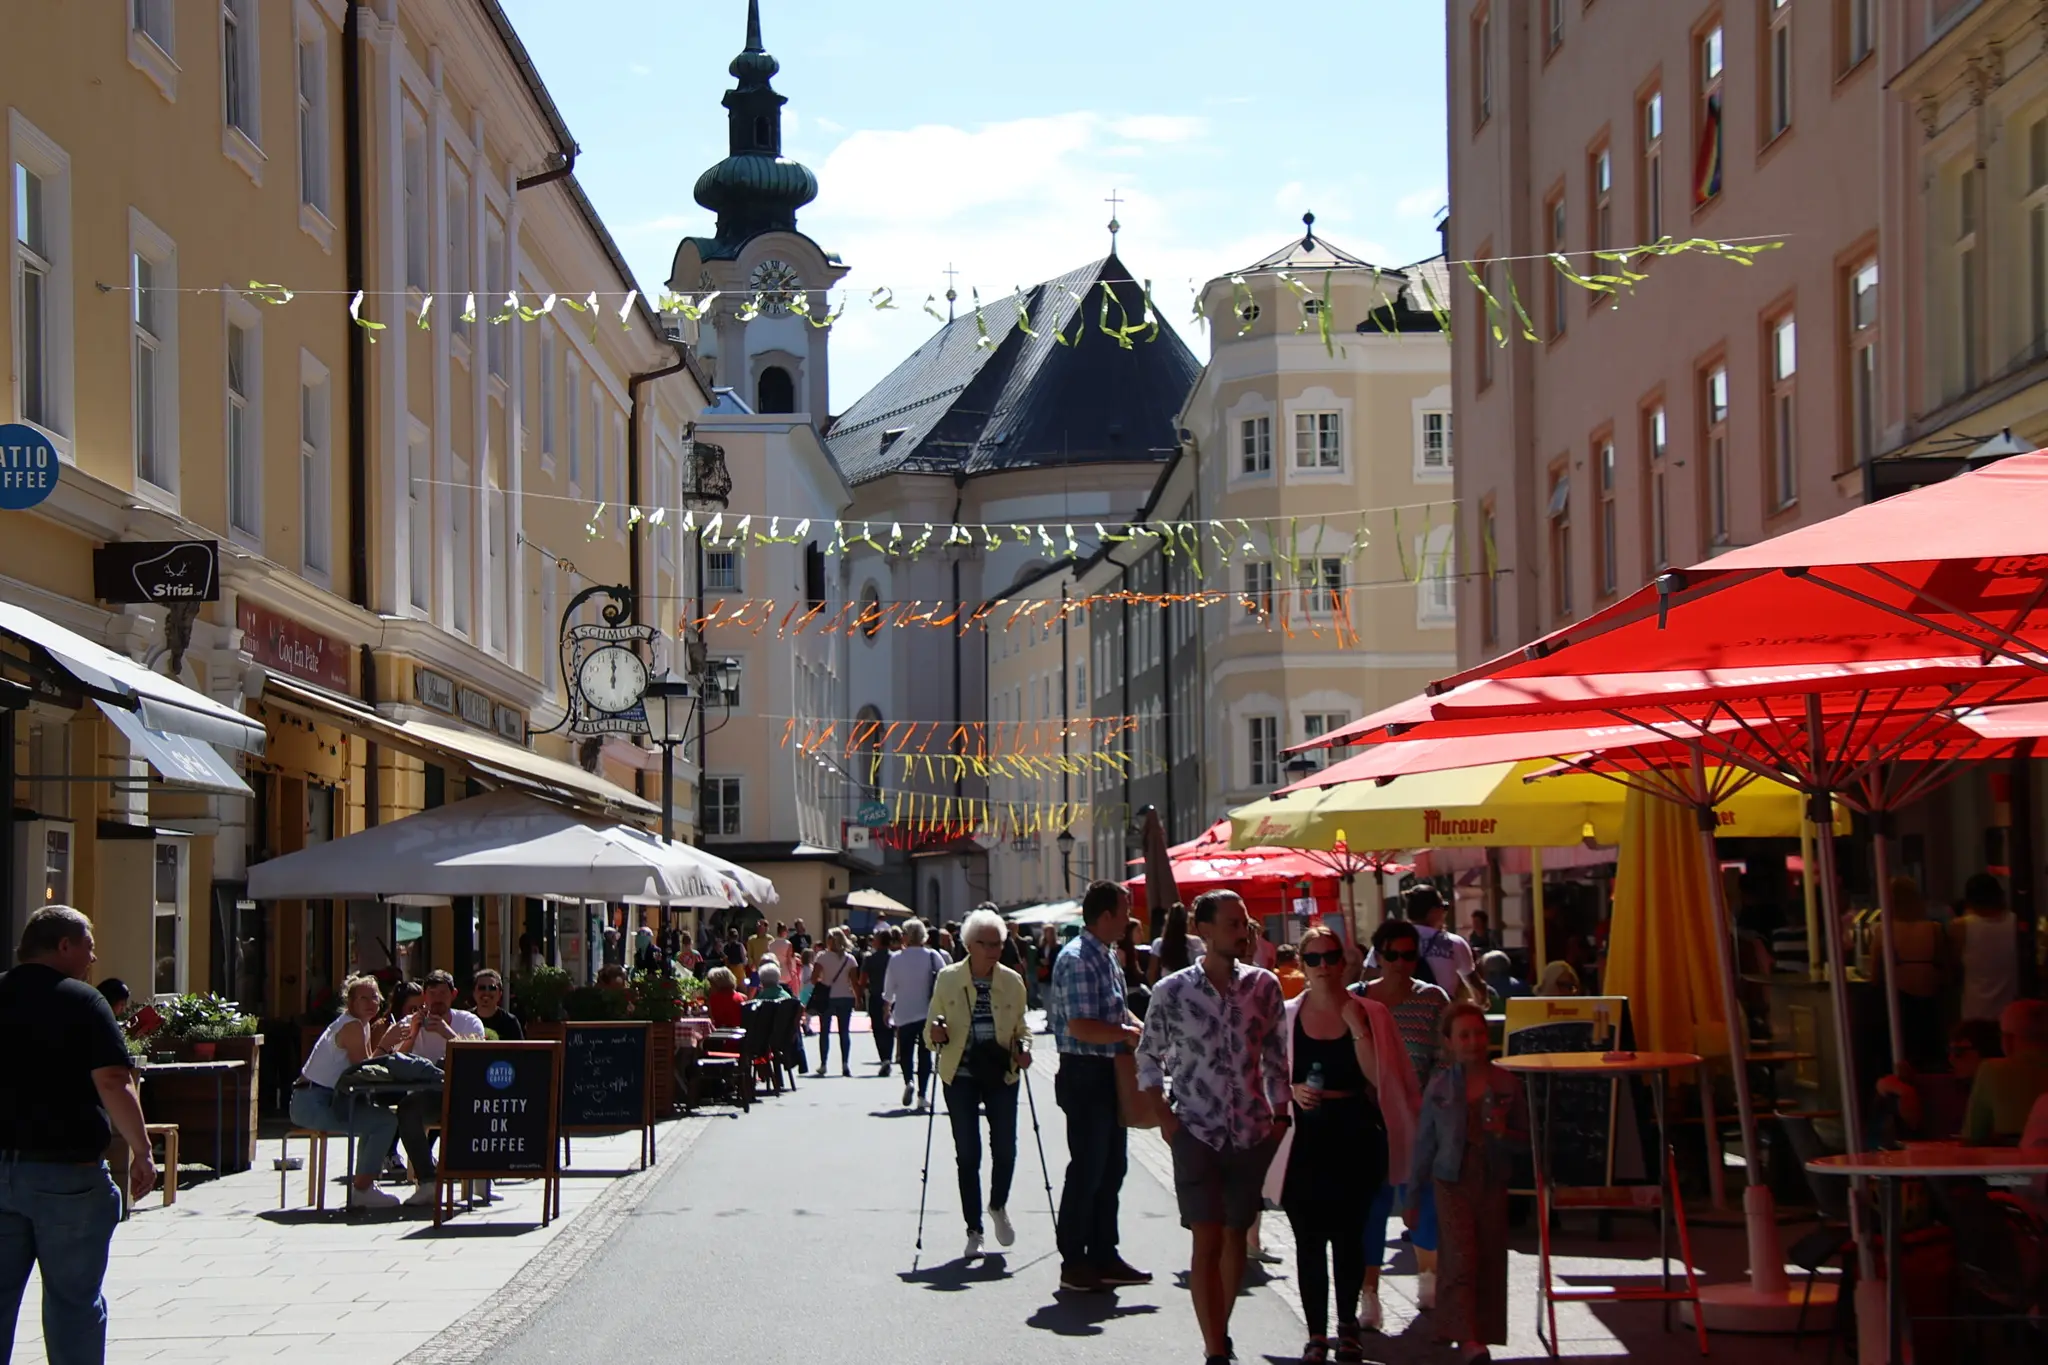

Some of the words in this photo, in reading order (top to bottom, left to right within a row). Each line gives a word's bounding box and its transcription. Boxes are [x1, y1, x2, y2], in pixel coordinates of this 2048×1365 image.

[580, 626, 644, 640] SCHMUCK
[278, 634, 293, 672] Coq
[294, 640, 304, 668] En
[582, 720, 645, 733] BICHLER
[1423, 810, 1498, 842] Murauer
[489, 1067, 513, 1075] RATIO
[473, 1099, 527, 1113] PRETTY
[491, 1118, 508, 1132] OK
[472, 1138, 525, 1152] COFFEE
